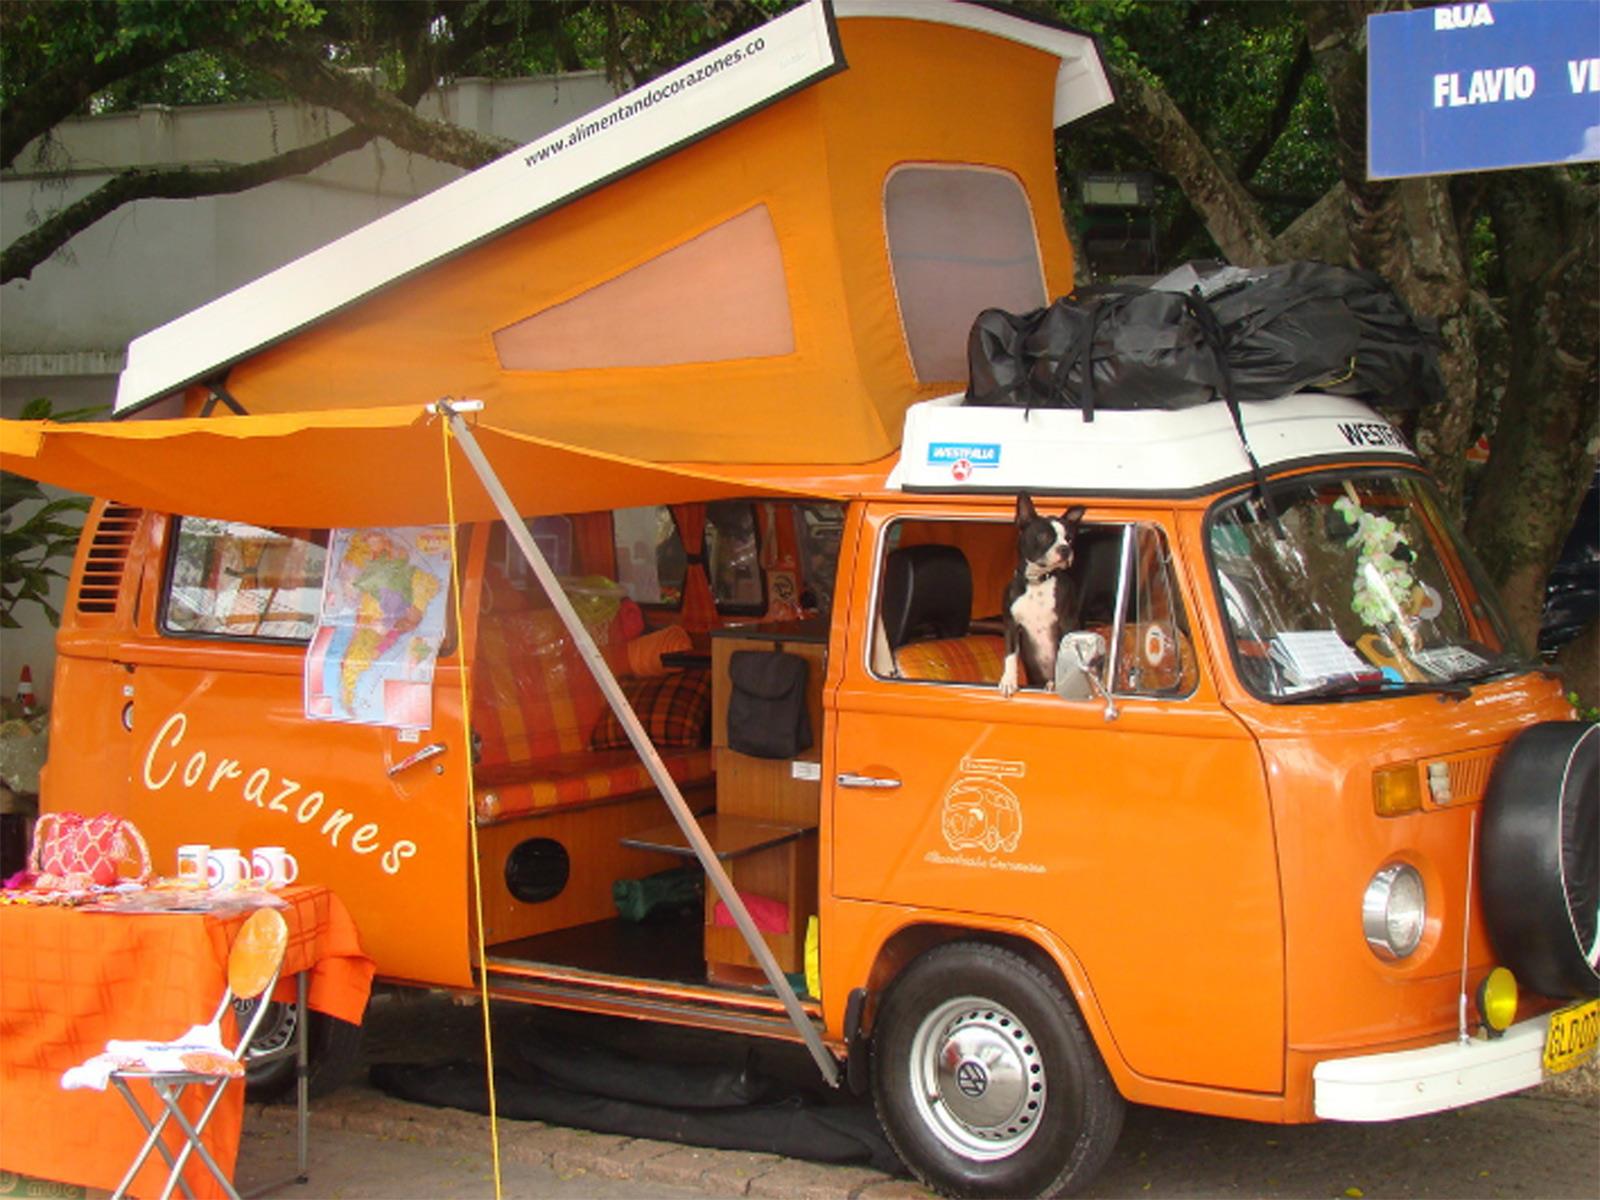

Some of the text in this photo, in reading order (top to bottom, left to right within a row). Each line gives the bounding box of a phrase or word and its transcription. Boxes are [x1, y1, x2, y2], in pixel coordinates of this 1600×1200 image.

[1434, 3, 1495, 31] RUA
[523, 37, 766, 168] www.alimentandocorazones.co
[1434, 64, 1536, 109] FLAVIO
[144, 712, 417, 875] Corazones
